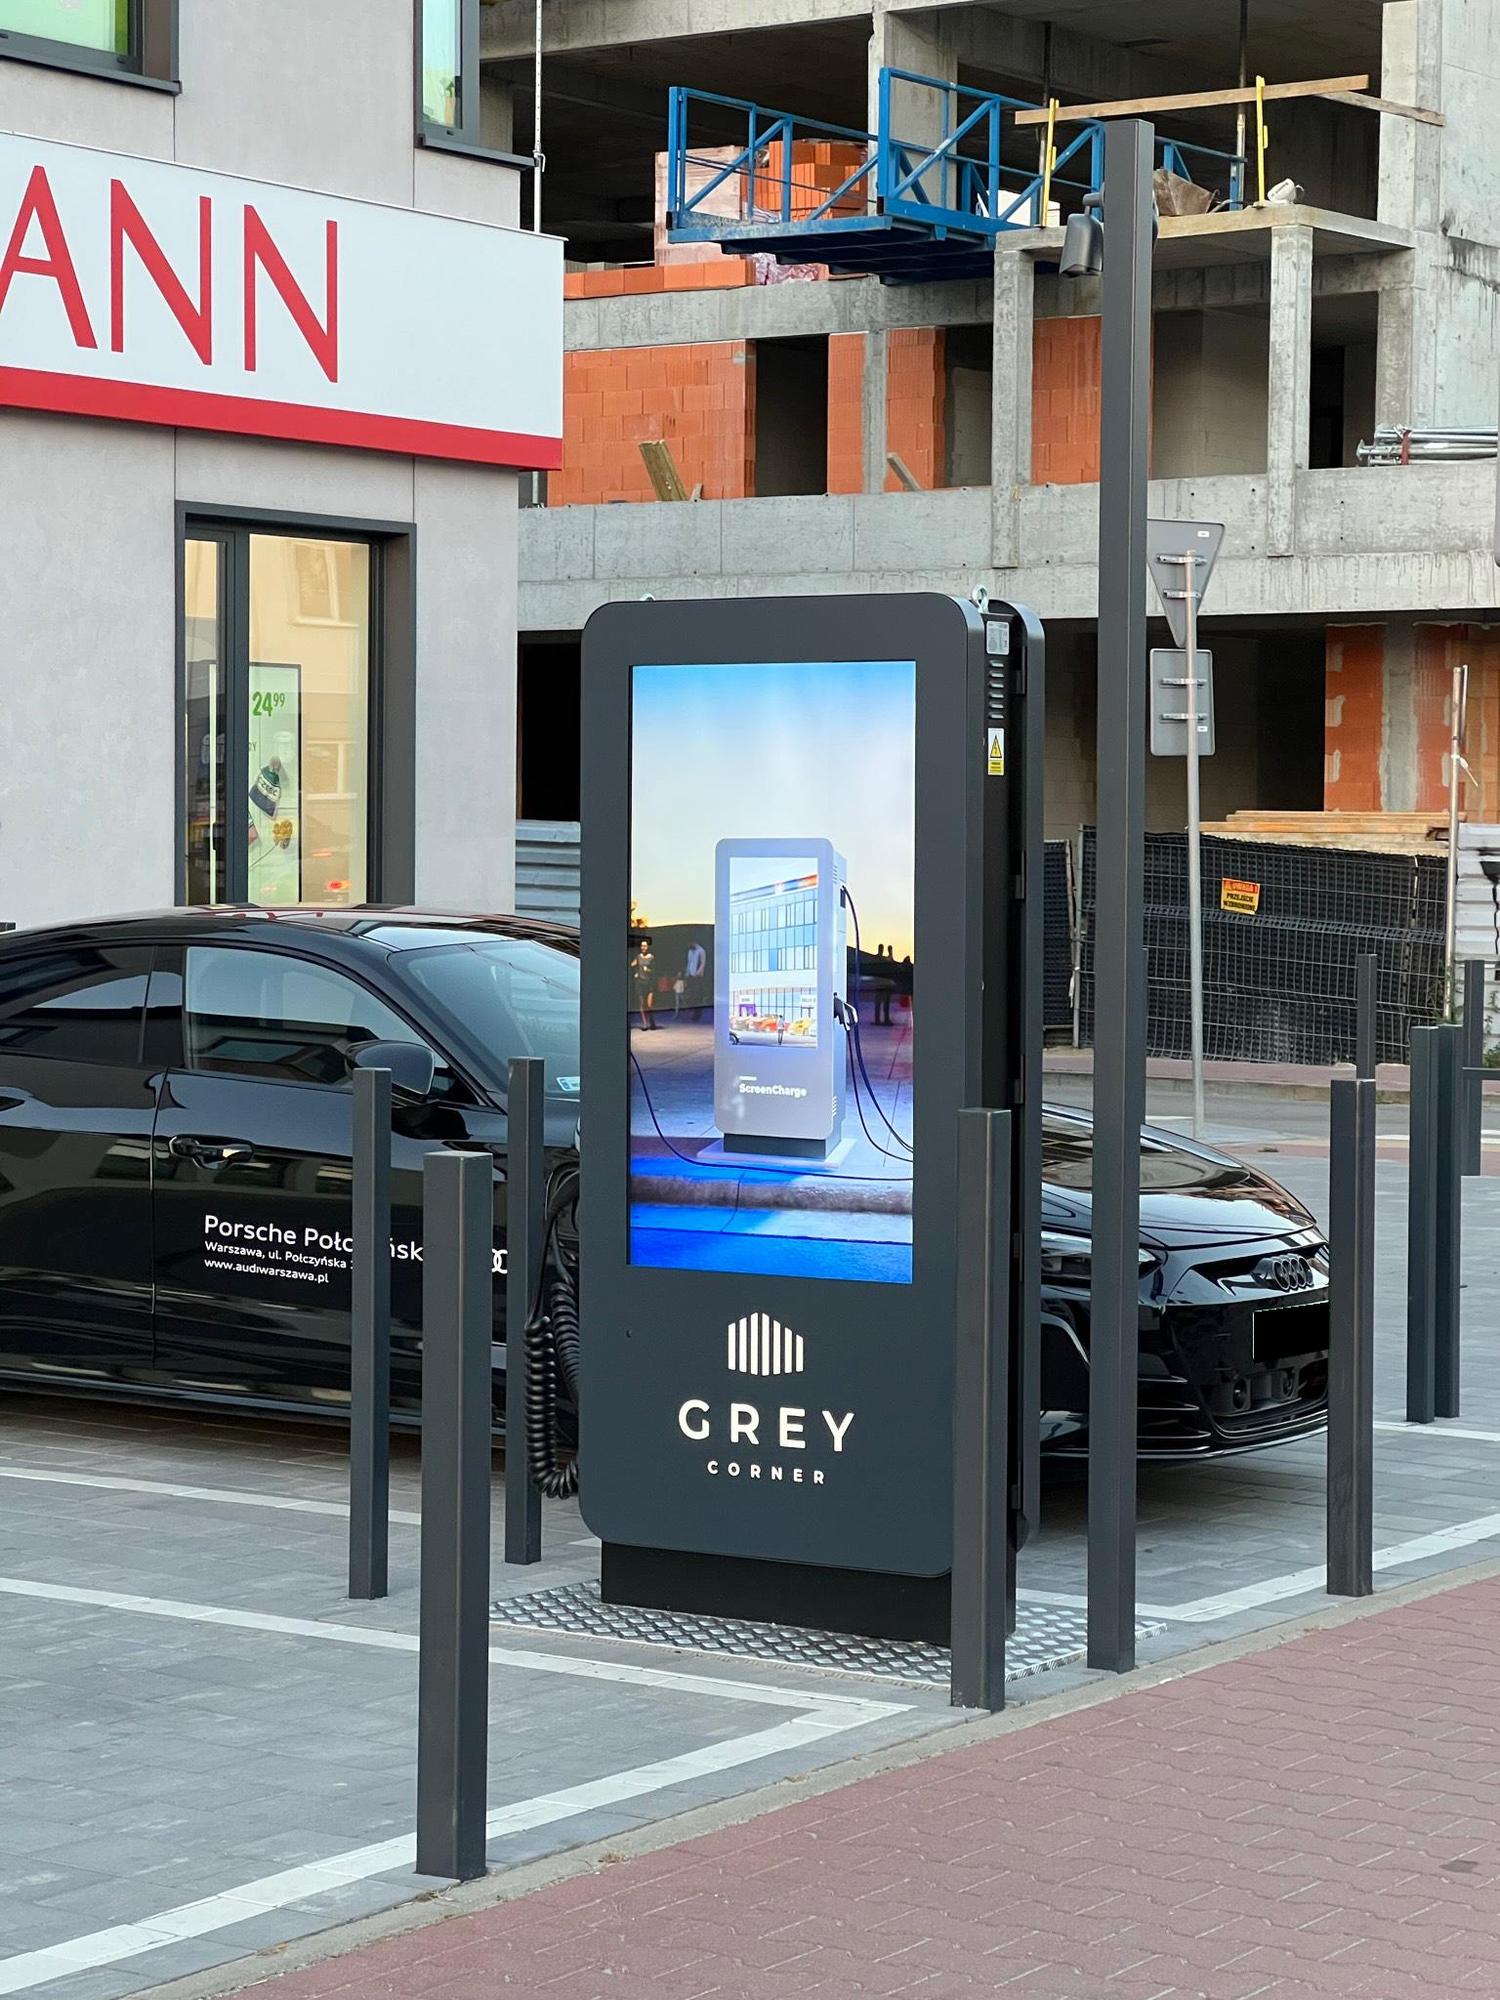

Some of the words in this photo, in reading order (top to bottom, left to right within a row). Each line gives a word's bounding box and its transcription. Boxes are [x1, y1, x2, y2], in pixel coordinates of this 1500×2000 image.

[0, 165, 338, 383] ANN
[739, 1083, 807, 1098] ScreenCharge
[204, 1214, 297, 1245] Porsche
[204, 1240, 266, 1259] Warszawa,
[268, 1250, 282, 1260] ul.
[204, 1259, 329, 1284] www.audiwarszawa.pl
[679, 1399, 854, 1452] GREY
[707, 1460, 825, 1485] CORNER
